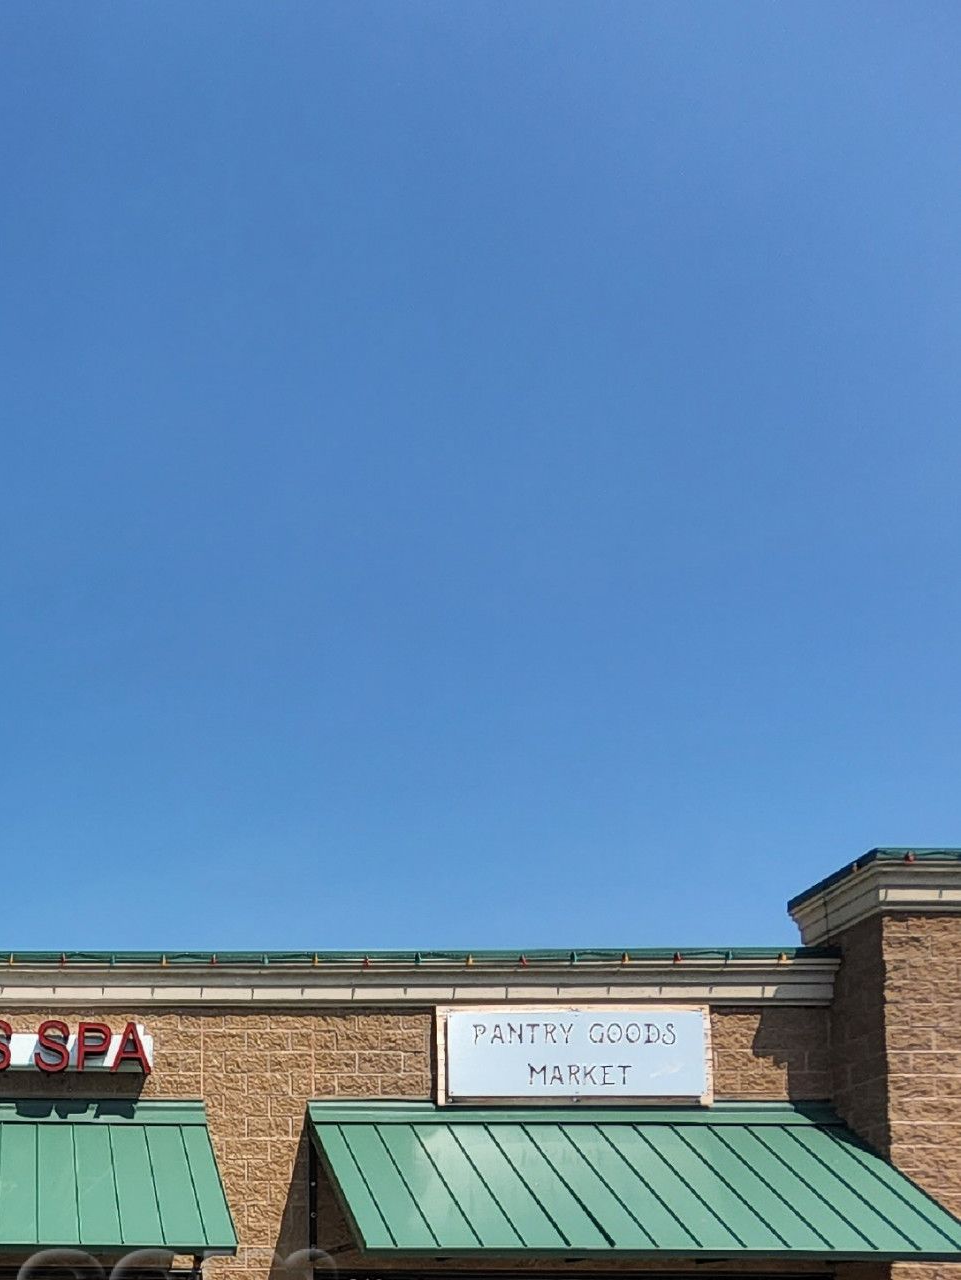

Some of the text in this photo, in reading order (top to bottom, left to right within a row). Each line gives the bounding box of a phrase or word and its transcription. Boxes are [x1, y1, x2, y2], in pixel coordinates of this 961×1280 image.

[472, 1022, 677, 1046] PANTRY GOODS
[34, 1020, 152, 1074] SPA
[527, 1063, 633, 1086] MARKET
